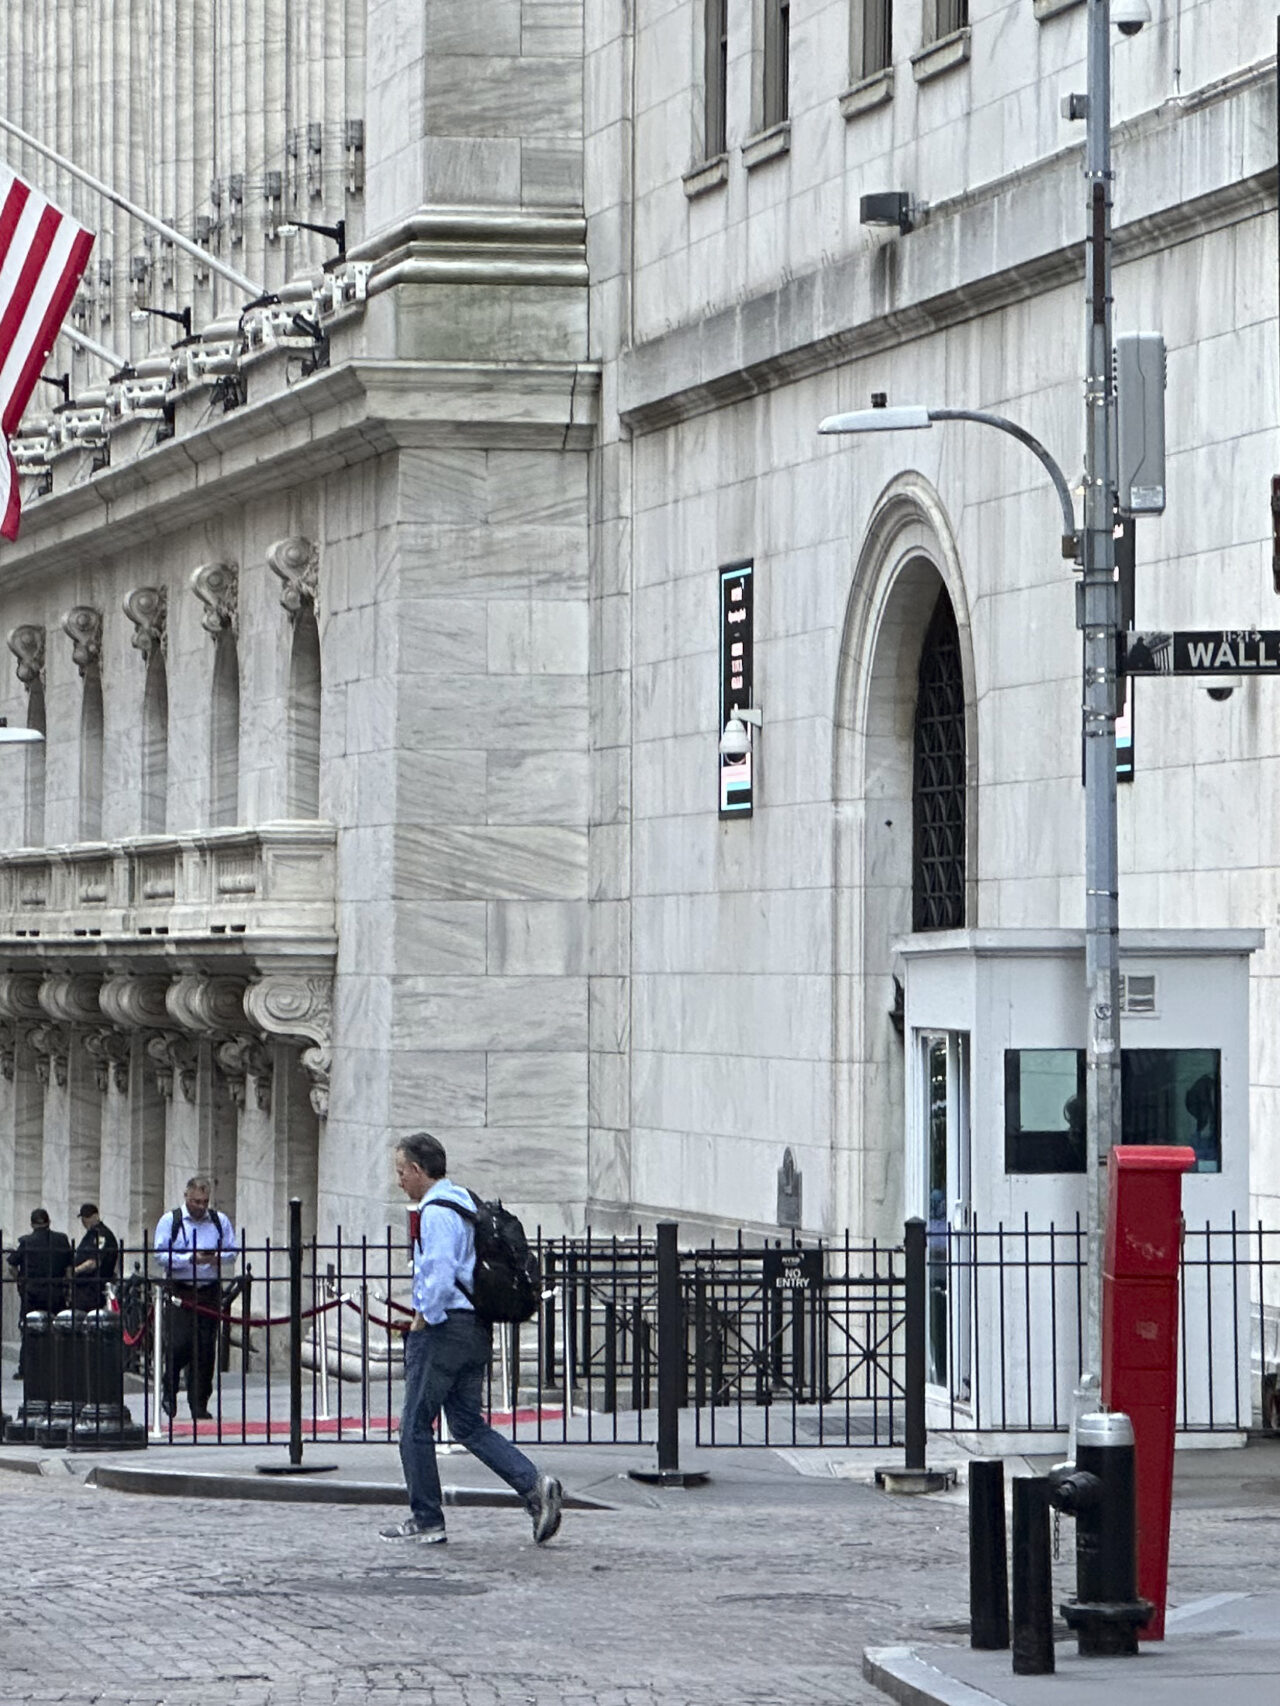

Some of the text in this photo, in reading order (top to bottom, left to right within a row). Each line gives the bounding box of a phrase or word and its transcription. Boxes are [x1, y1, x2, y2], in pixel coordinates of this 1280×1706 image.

[1187, 642, 1278, 667] WALL
[785, 1268, 801, 1279] NO
[776, 1277, 810, 1288] ENTRY
